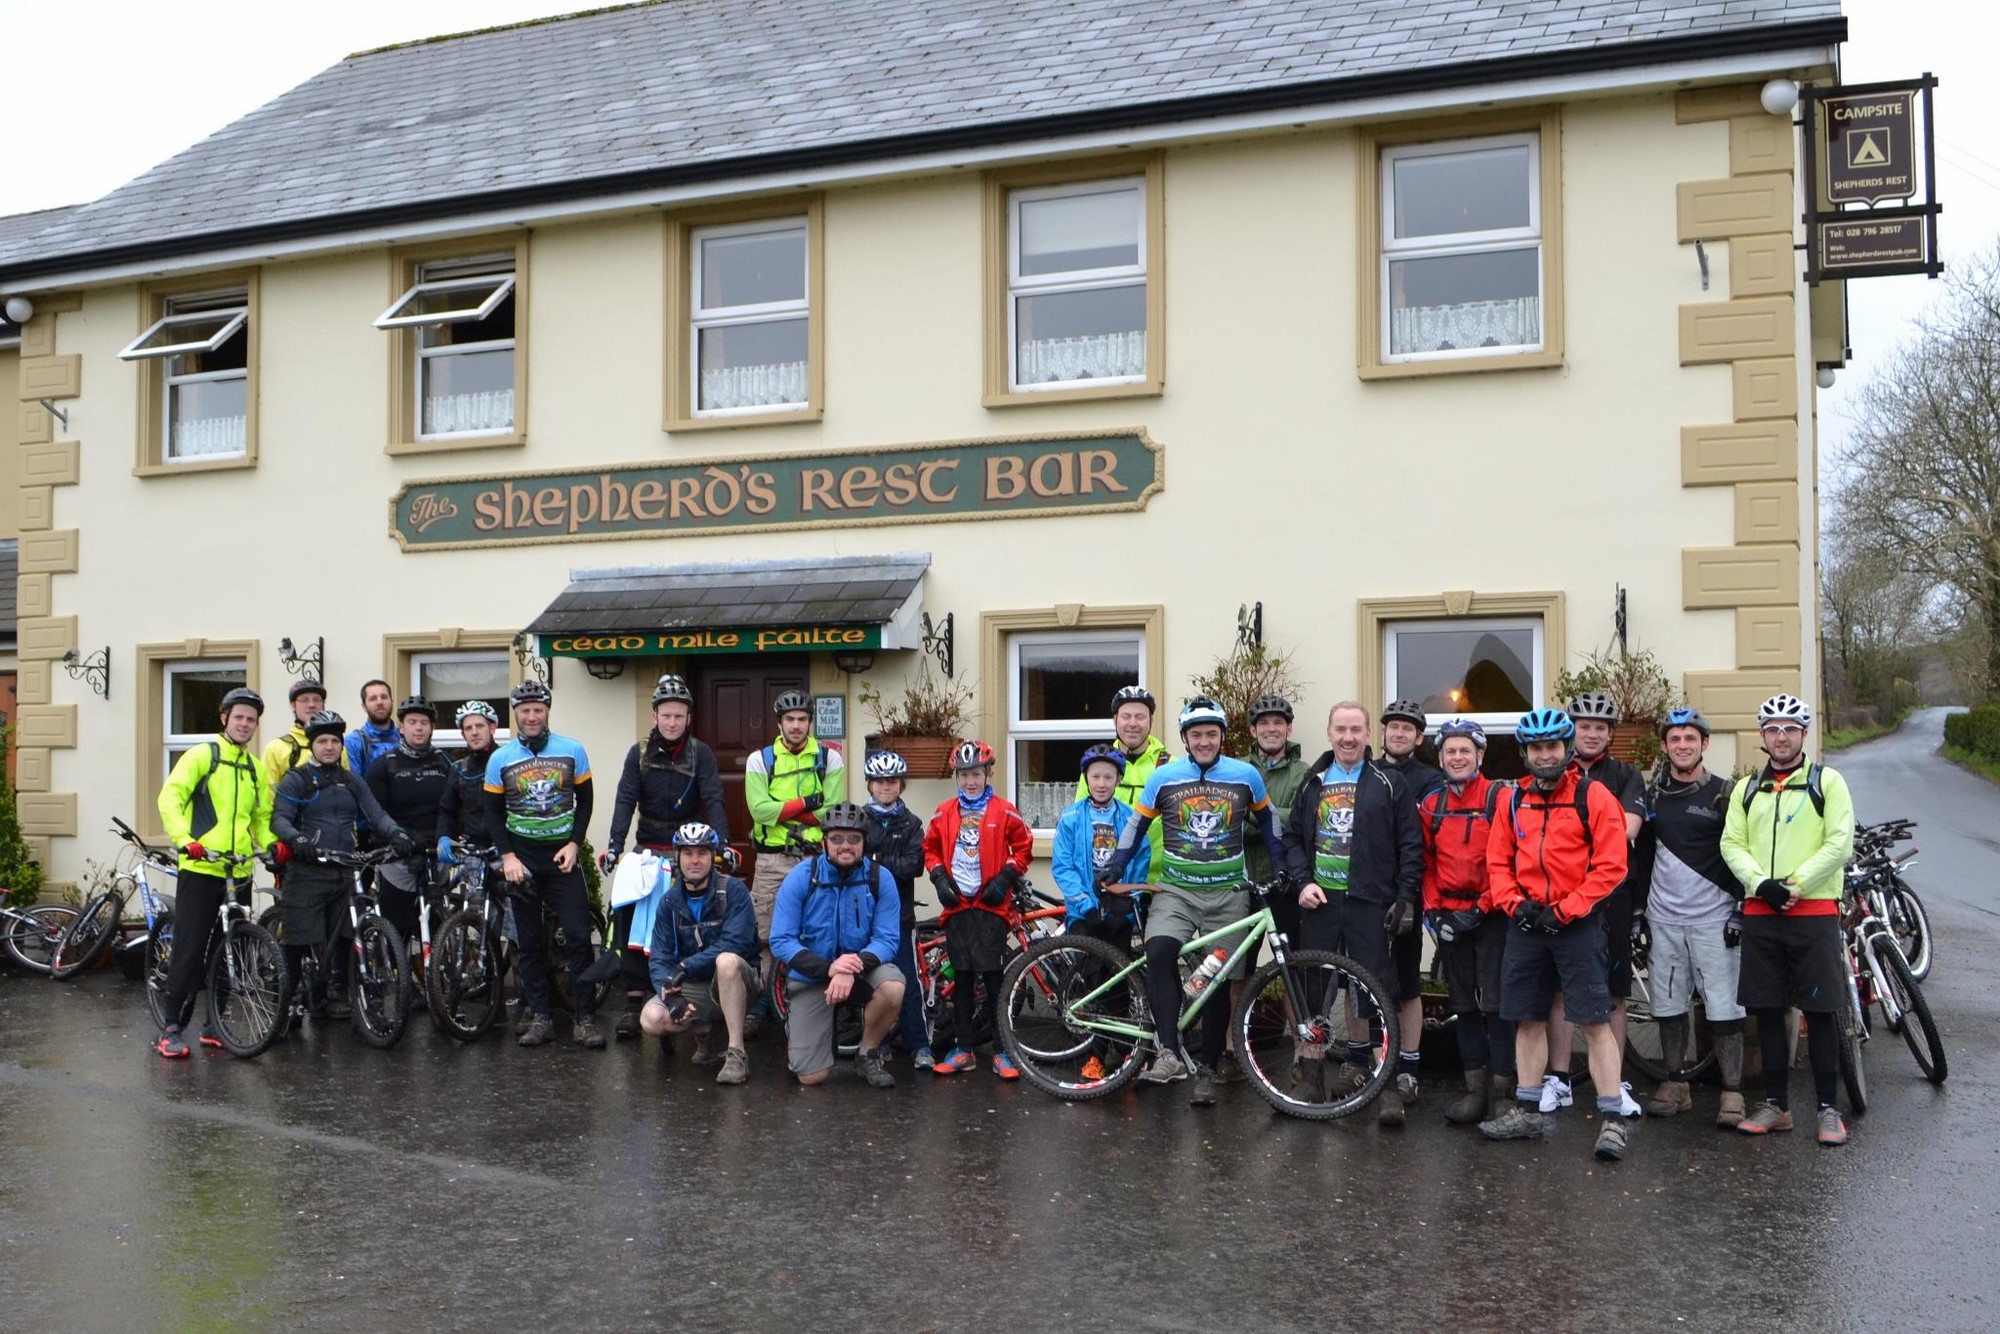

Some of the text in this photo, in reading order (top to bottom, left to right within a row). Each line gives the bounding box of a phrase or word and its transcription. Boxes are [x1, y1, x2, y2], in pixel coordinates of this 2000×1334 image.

[1834, 103, 1903, 120] CAMPSITE
[1834, 175, 1907, 190] SHEPHERDS REST
[1829, 229, 1844, 238] Tel:
[1846, 228, 1861, 237] 028
[1863, 226, 1877, 235] 796
[409, 493, 458, 533] The
[1169, 786, 1240, 802] TRAILBADGER
